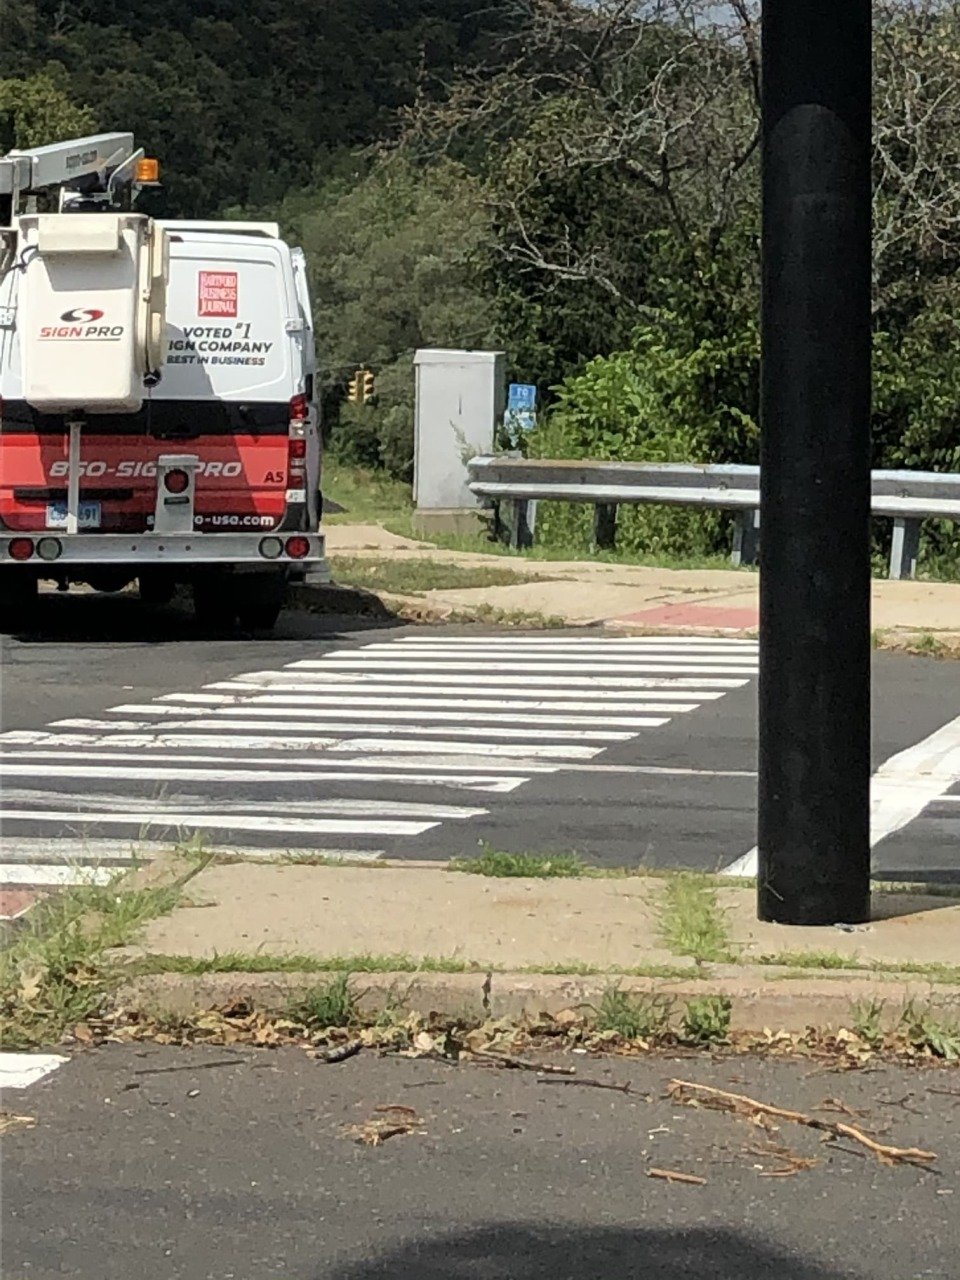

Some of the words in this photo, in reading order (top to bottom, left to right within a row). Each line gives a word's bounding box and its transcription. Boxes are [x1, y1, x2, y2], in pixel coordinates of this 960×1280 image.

[40, 326, 82, 338] SIGN
[85, 325, 124, 337] PRO
[183, 326, 232, 338] VOTED
[198, 341, 273, 353] COMPANY
[166, 354, 195, 364] BEST
[197, 356, 209, 365] IN
[211, 356, 266, 366] BUSINESS
